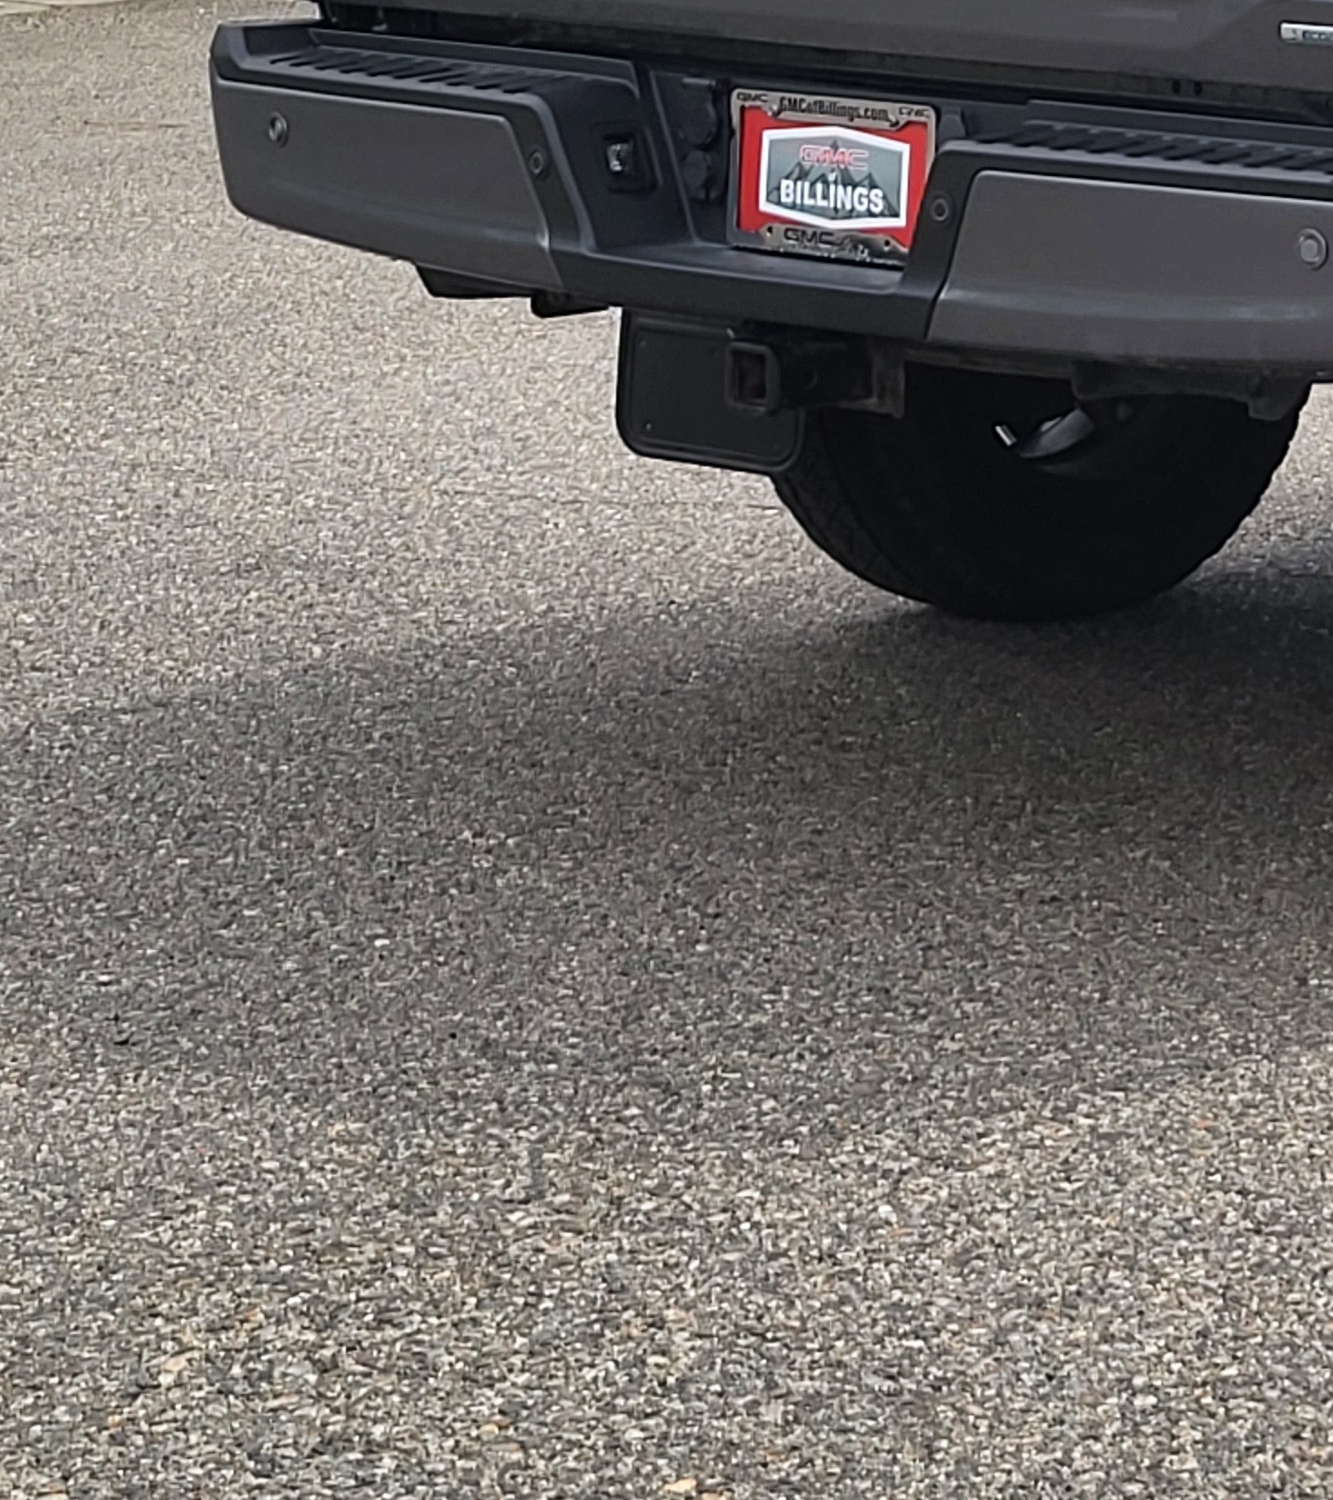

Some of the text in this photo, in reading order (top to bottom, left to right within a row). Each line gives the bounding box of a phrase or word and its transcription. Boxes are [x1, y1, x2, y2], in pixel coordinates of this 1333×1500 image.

[800, 144, 869, 171] GMC
[780, 178, 884, 213] BILLINGS
[783, 227, 840, 248] GMC
